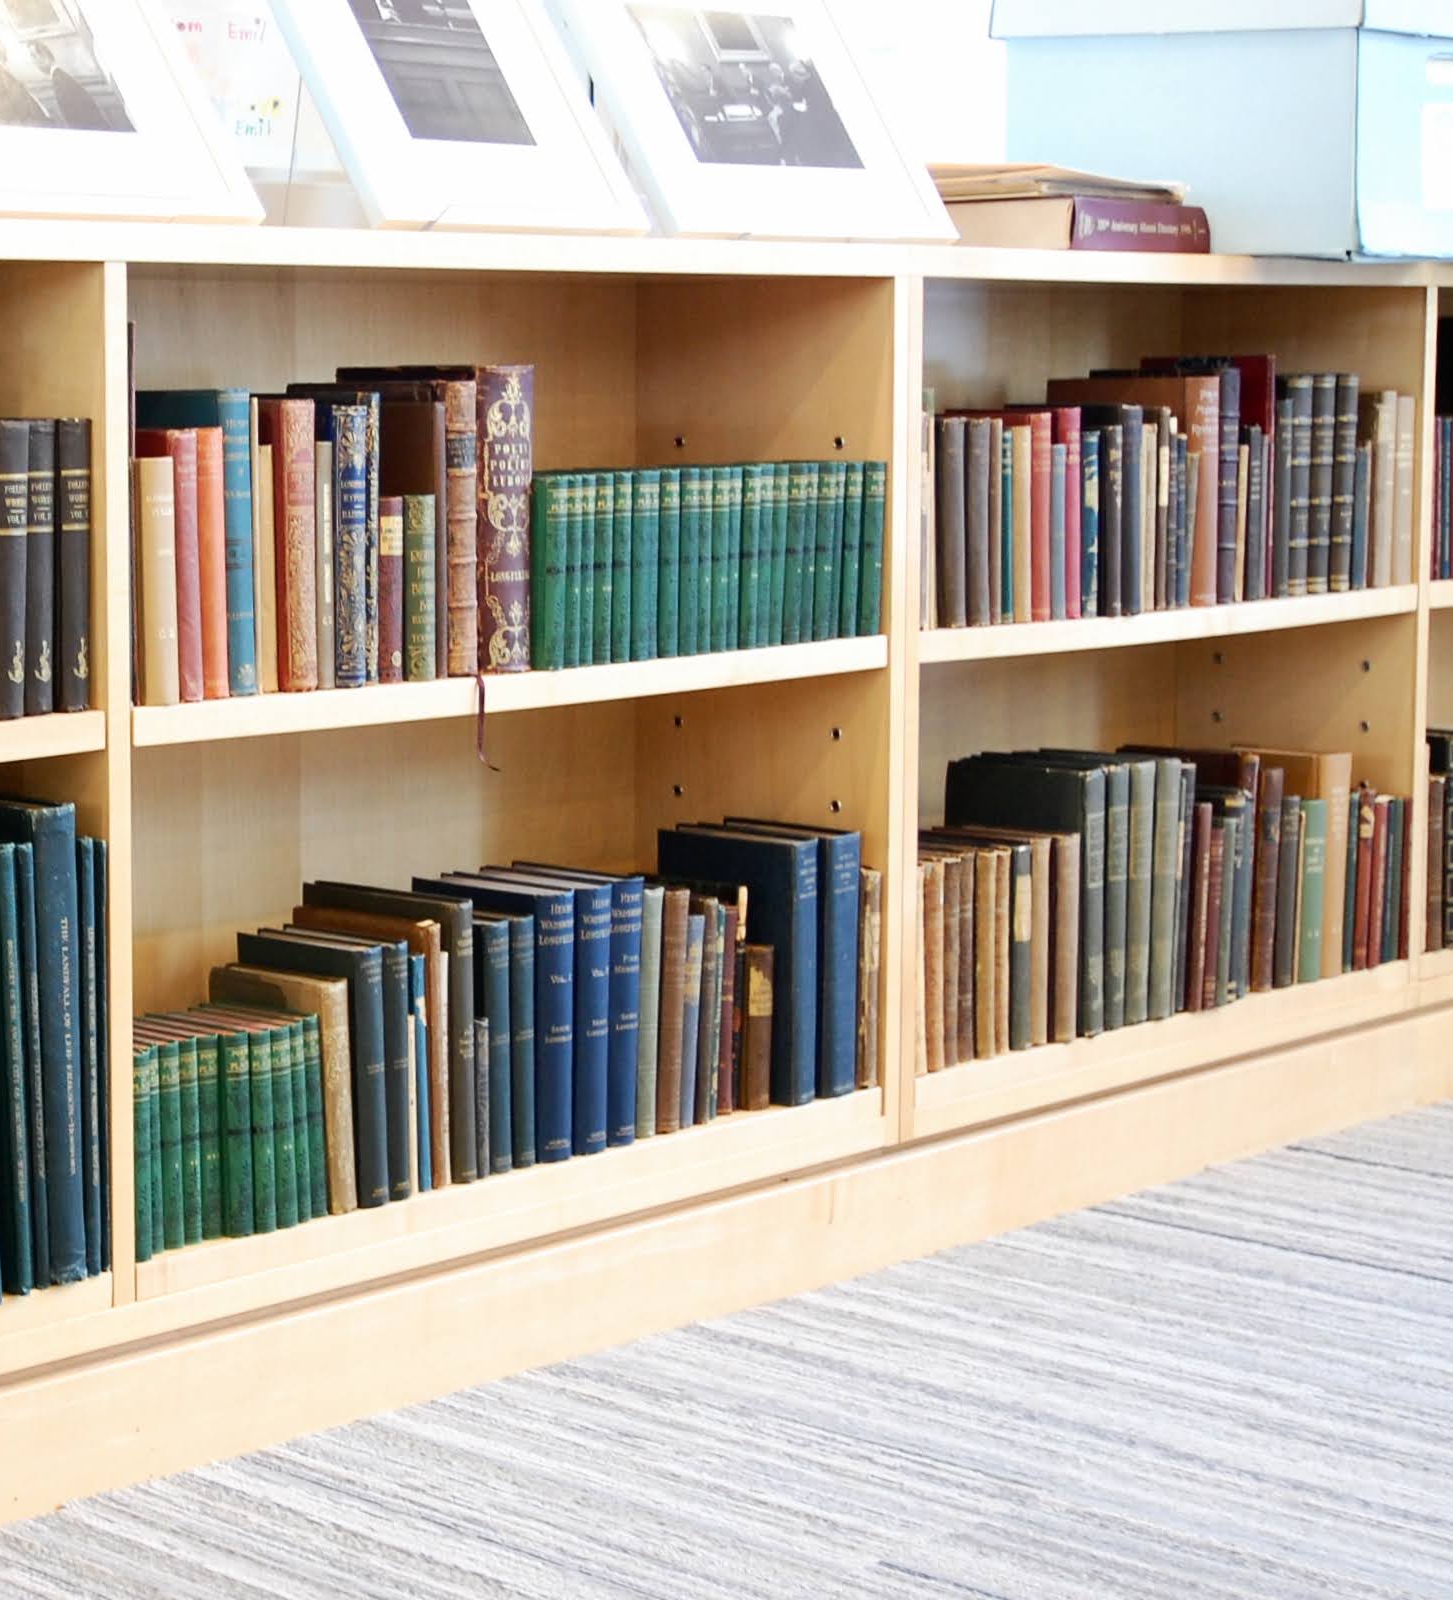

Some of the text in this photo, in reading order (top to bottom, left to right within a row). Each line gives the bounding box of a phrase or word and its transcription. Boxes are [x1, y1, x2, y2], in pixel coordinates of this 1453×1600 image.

[235, 118, 271, 137] Emil
[490, 459, 530, 472] POETR
[60, 917, 69, 941] THE
[61, 946, 73, 1009] LANDFALL
[63, 1013, 72, 1028] OF
